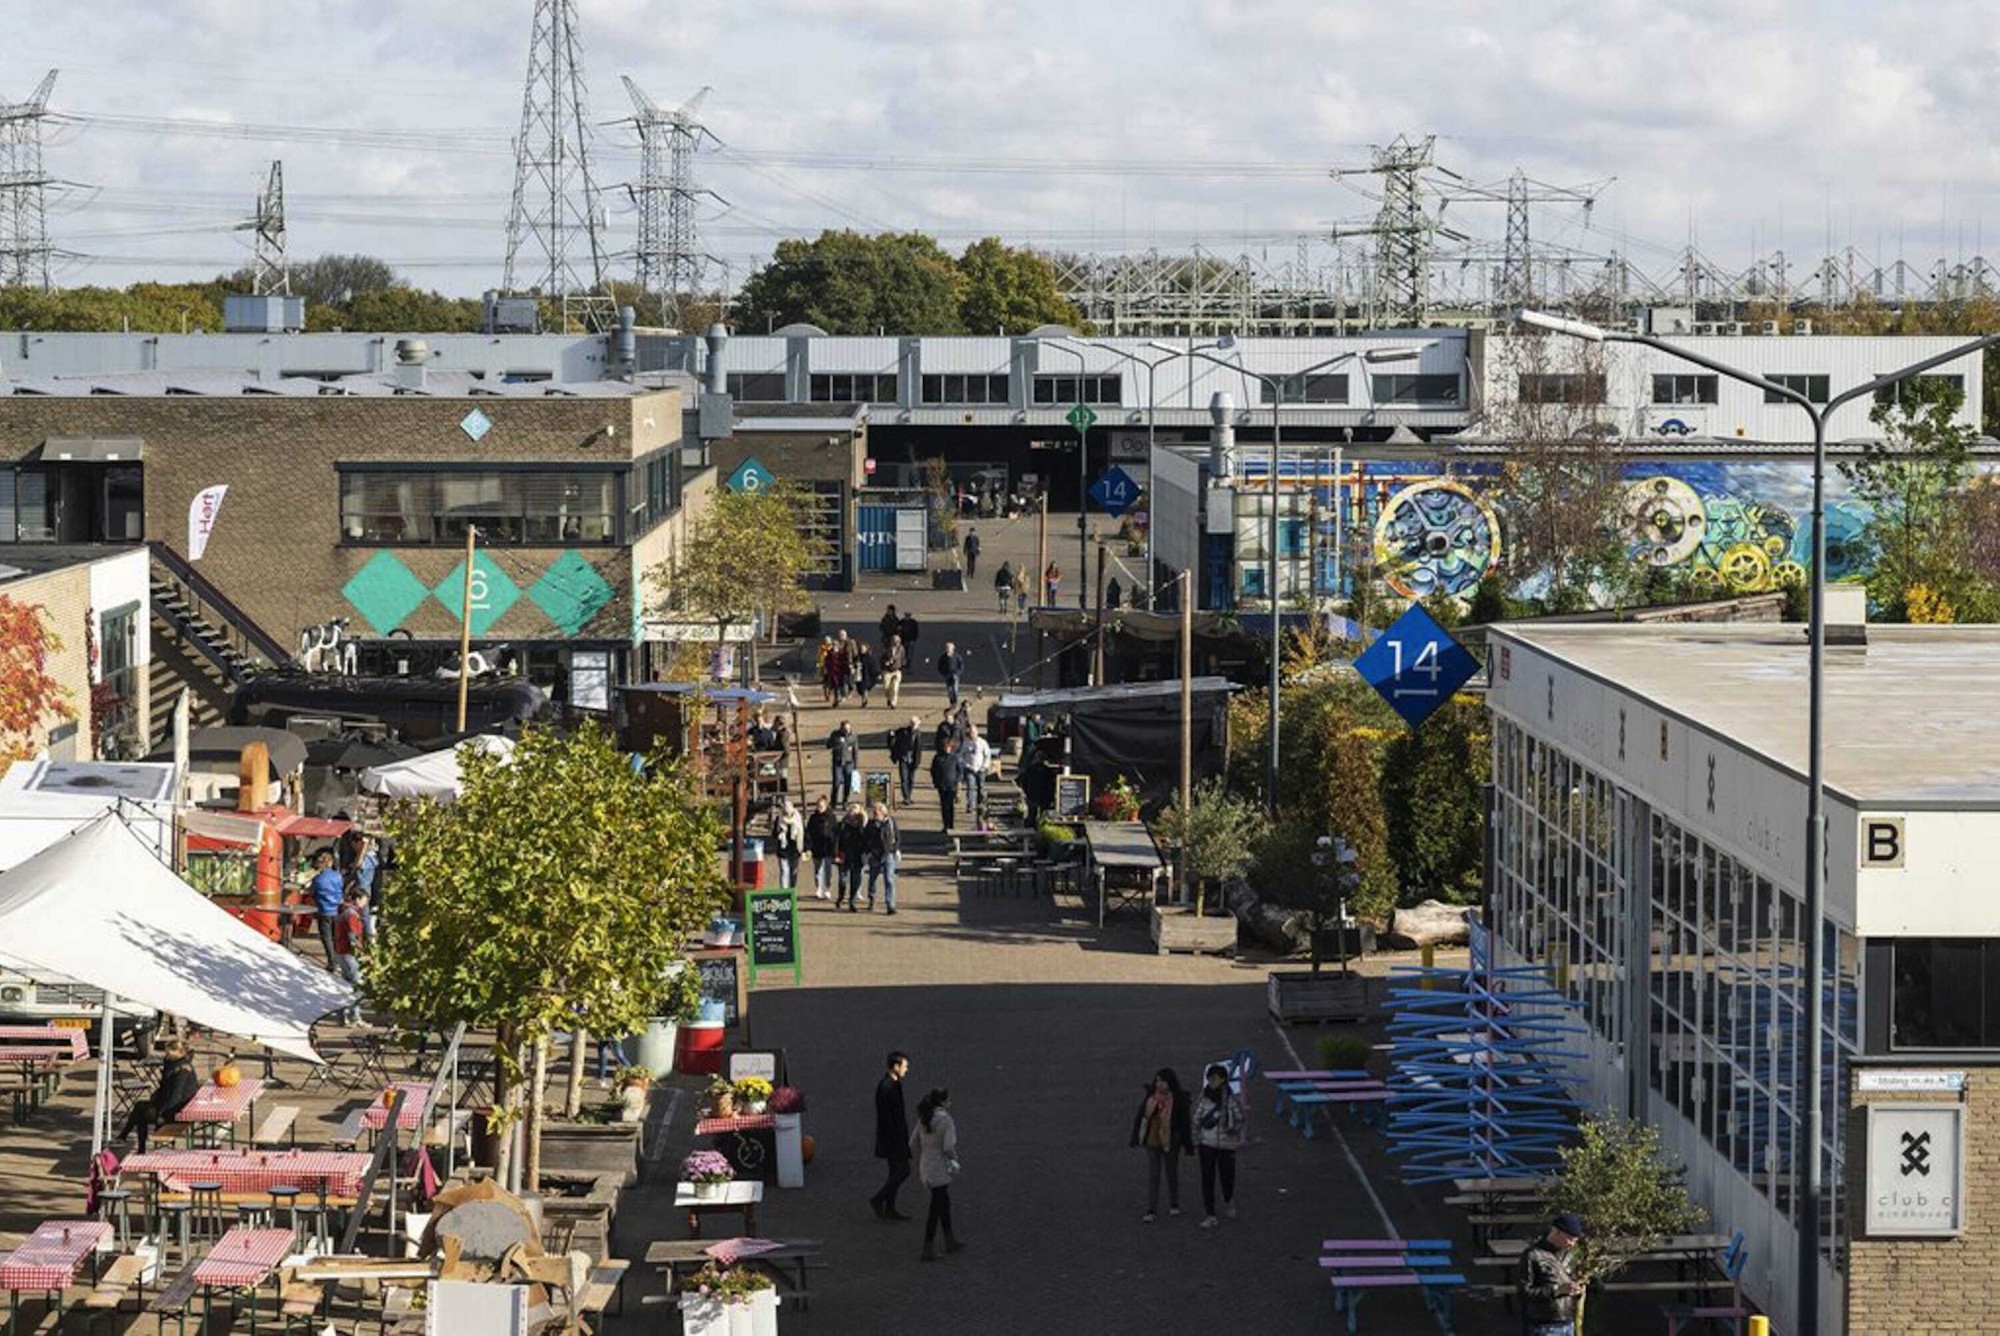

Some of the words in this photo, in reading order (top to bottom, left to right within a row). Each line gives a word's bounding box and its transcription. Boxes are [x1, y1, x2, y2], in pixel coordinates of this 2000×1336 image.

[743, 468, 759, 490] 6
[1103, 480, 1127, 499] 14
[468, 569, 489, 600] 6
[1386, 640, 1442, 682] 14
[1868, 823, 1898, 861] B
[1878, 1190, 1928, 1206] club
[1941, 1196, 1951, 1206] c
